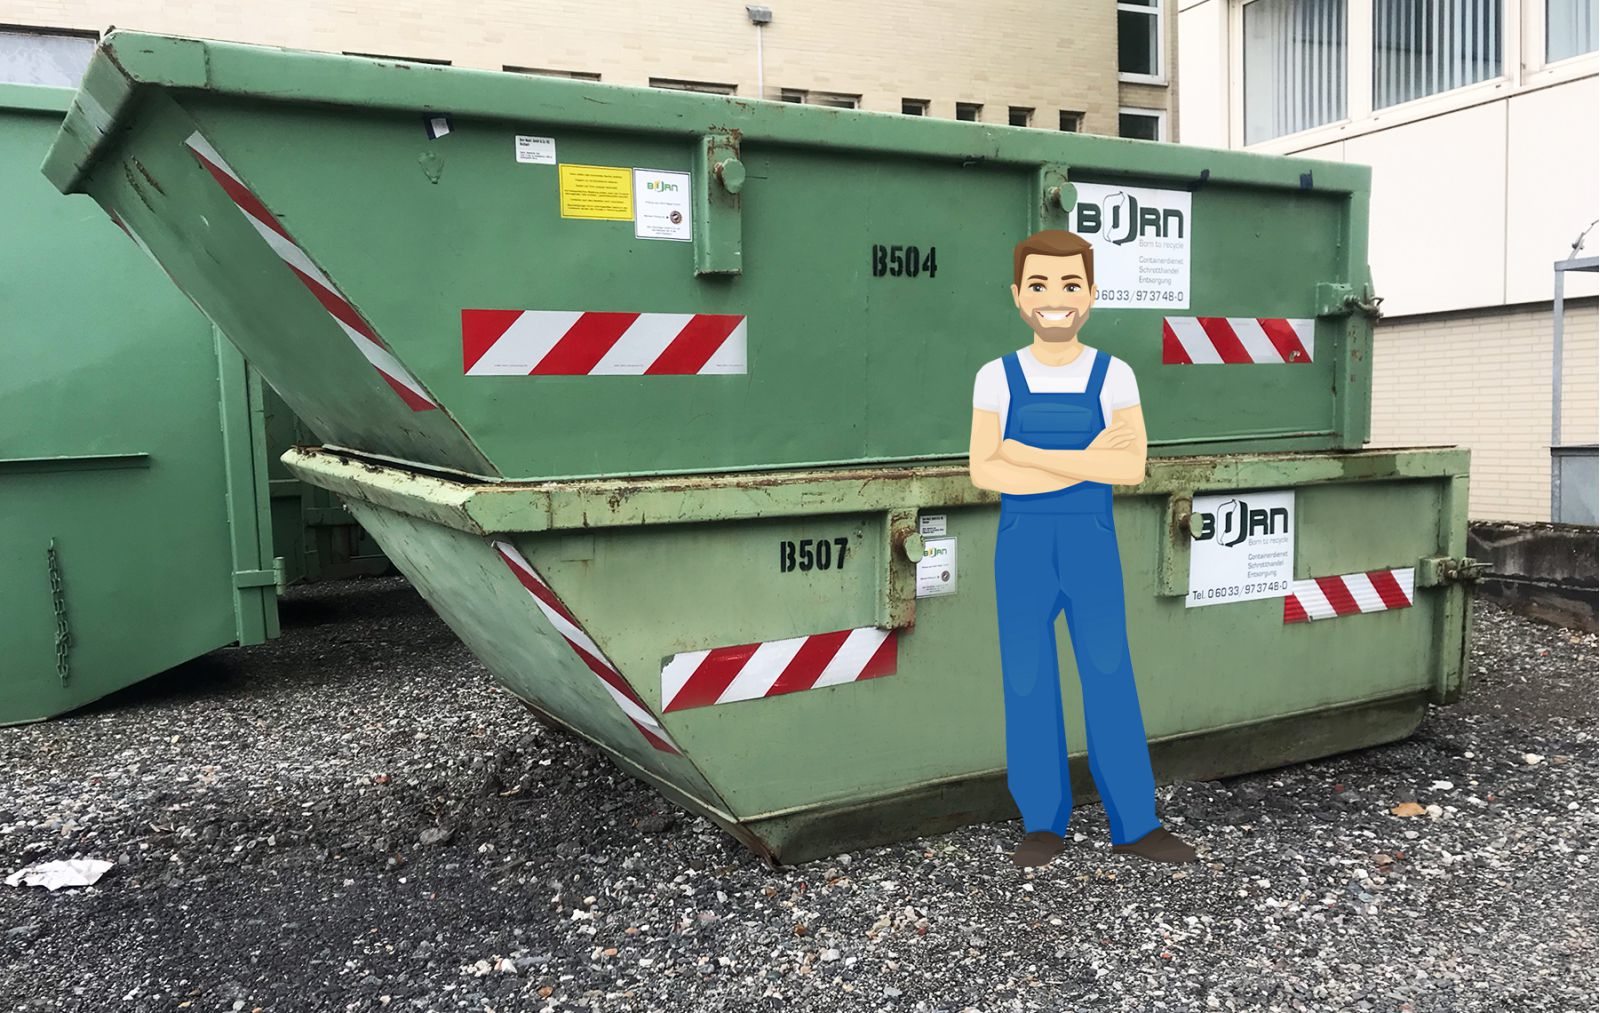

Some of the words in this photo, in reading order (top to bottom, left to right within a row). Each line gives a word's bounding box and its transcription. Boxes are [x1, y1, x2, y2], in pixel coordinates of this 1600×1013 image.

[1139, 239, 1154, 248] Born
[1163, 242, 1184, 250] recycle
[872, 244, 937, 278] B504
[1139, 275, 1172, 286] Entsorgung
[780, 537, 848, 573] B507
[1193, 590, 1206, 600] Tel.
